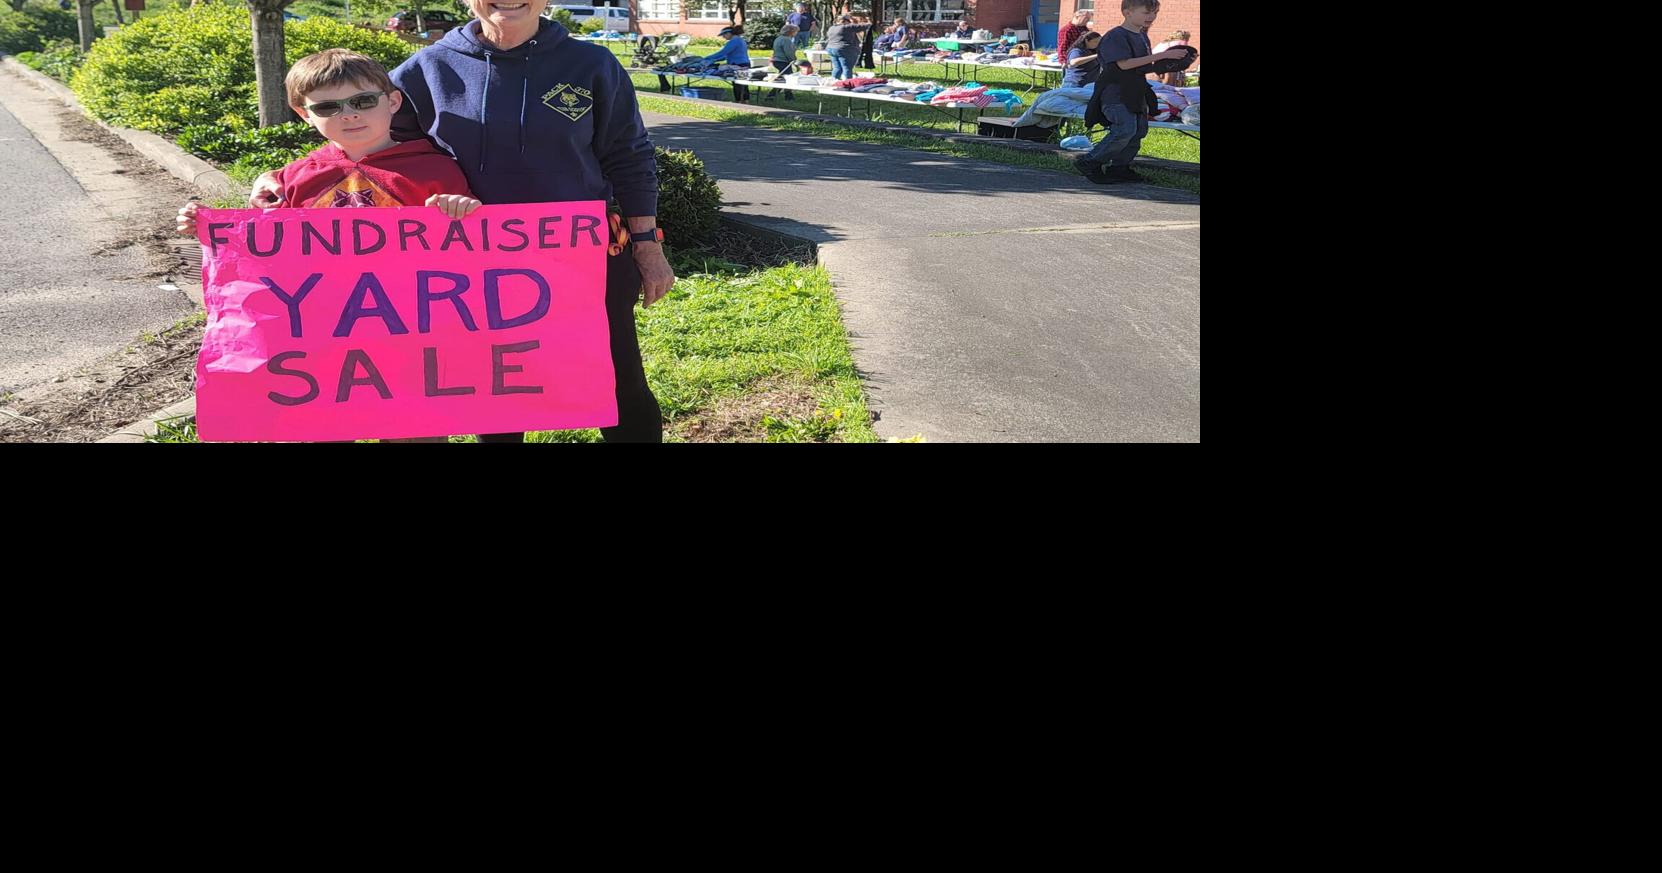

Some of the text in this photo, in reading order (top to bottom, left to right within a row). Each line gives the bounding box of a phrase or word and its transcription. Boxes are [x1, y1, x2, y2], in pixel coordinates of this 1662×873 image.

[208, 215, 602, 257] FUNDRAISER
[260, 268, 551, 338] YARD
[266, 340, 545, 406] SALE
